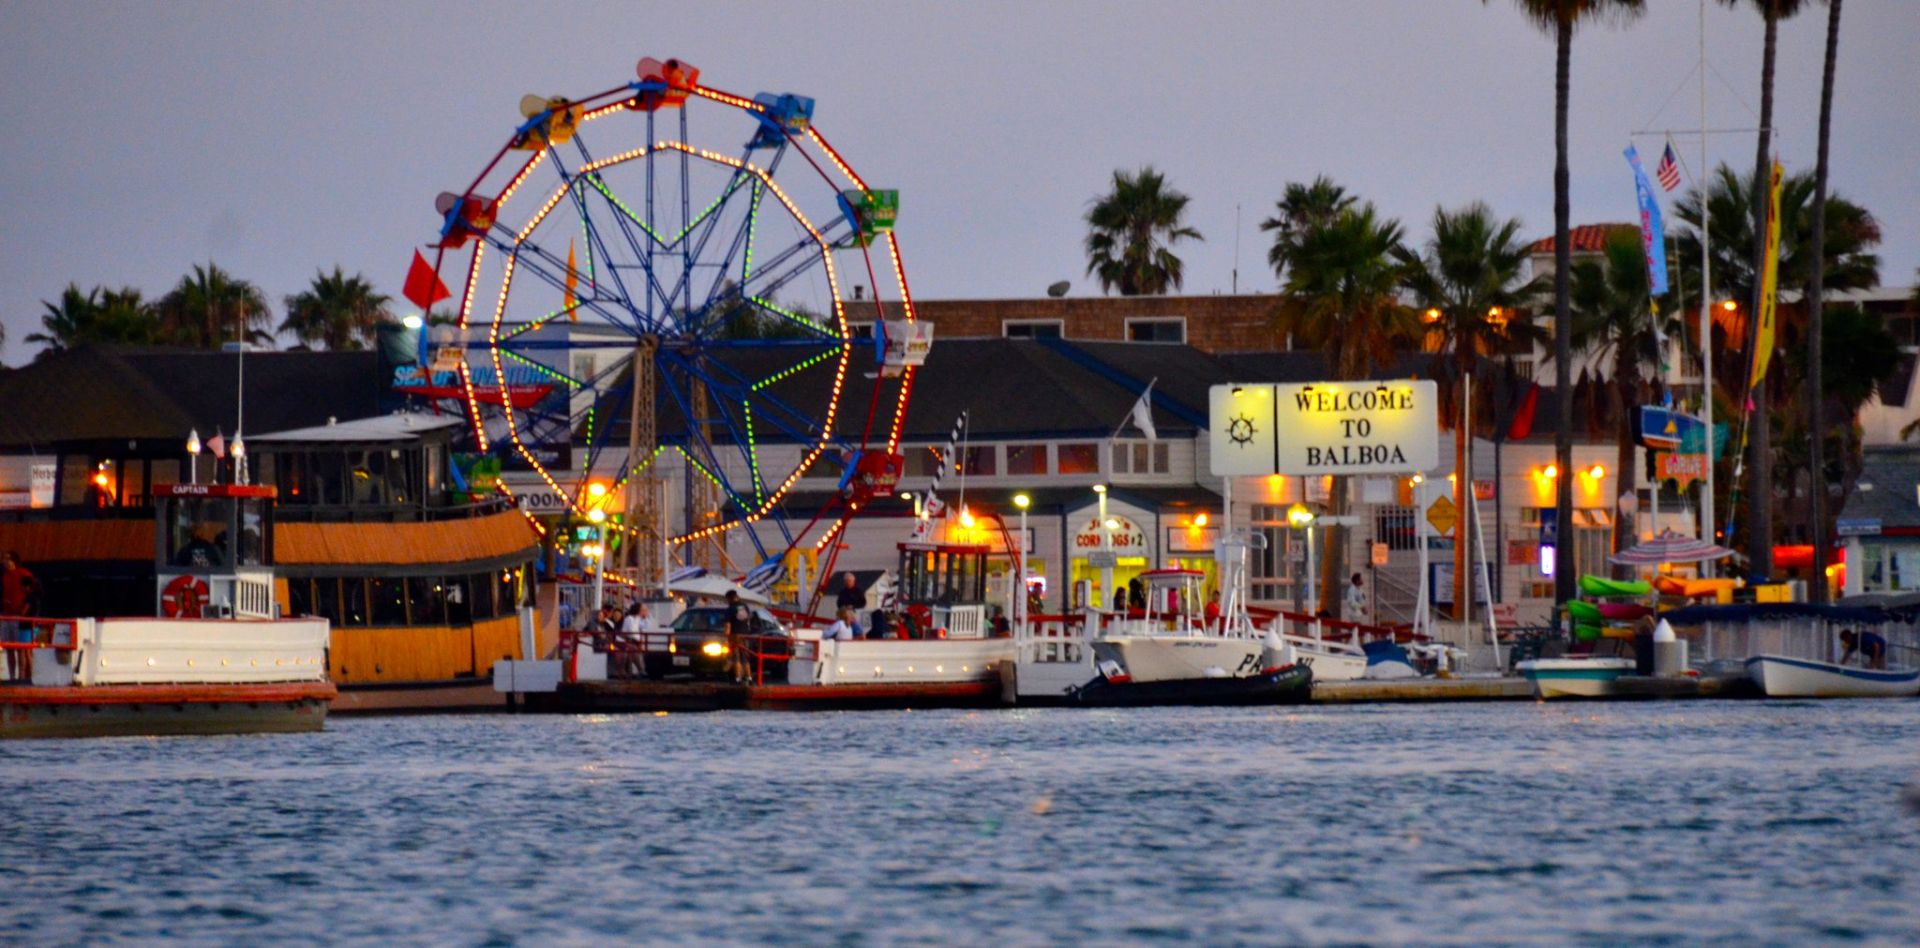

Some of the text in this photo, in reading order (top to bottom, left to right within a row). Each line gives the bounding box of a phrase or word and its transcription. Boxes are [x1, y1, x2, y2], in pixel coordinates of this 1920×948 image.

[1295, 389, 1414, 413] WELCOME
[1340, 418, 1371, 439] TO
[1306, 444, 1407, 467] BALBOA
[172, 485, 209, 495] CAPTAIN
